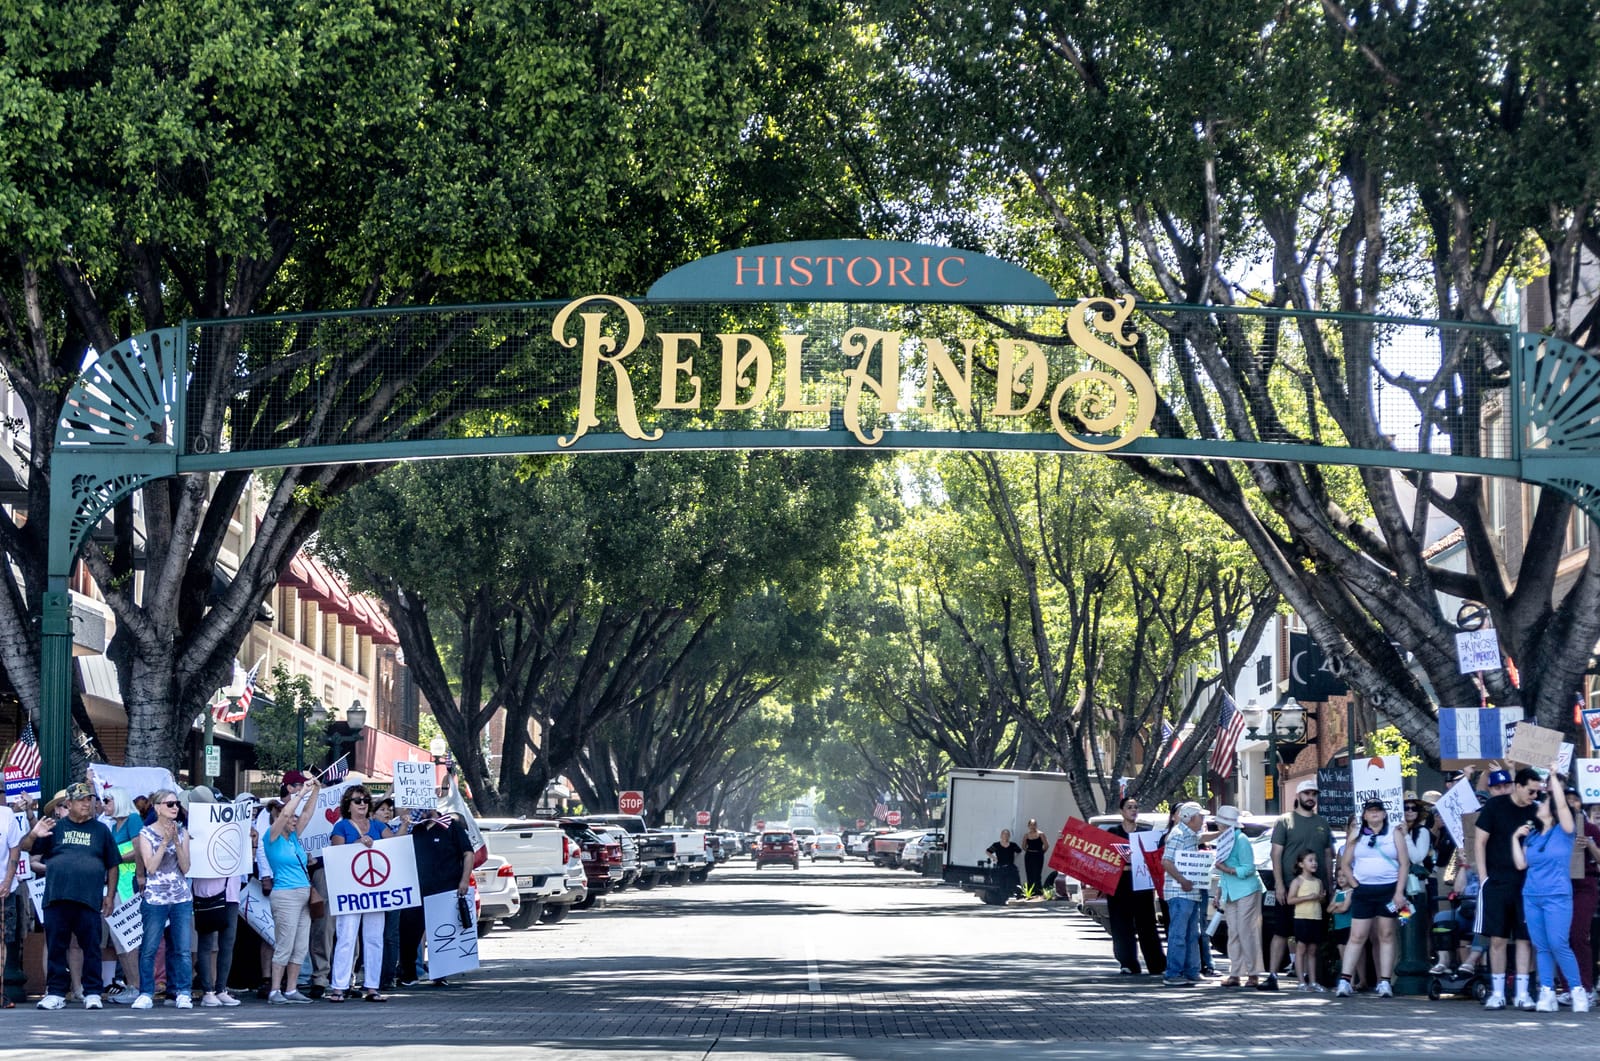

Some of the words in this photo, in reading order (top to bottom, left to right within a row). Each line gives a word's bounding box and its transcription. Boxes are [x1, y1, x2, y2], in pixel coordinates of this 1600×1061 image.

[733, 255, 968, 287] HISTORIC
[551, 293, 1156, 451] REDLANDS
[5, 771, 23, 780] SAVE
[397, 762, 416, 774] FED
[417, 763, 431, 775] UP
[6, 780, 39, 790] DEMOCRACY
[398, 776, 417, 786] WITH
[419, 779, 432, 787] HIS
[620, 799, 643, 809] STOP
[210, 805, 234, 823] NO
[64, 830, 91, 840] VIETNAM
[1063, 834, 1122, 866] PRIVILEGE
[111, 909, 121, 918] WE
[121, 895, 144, 912] BELIEV
[336, 887, 413, 912] PROTEST
[113, 918, 126, 929] THE
[122, 928, 132, 937] WE
[132, 921, 143, 930] WO
[433, 923, 457, 953] NO
